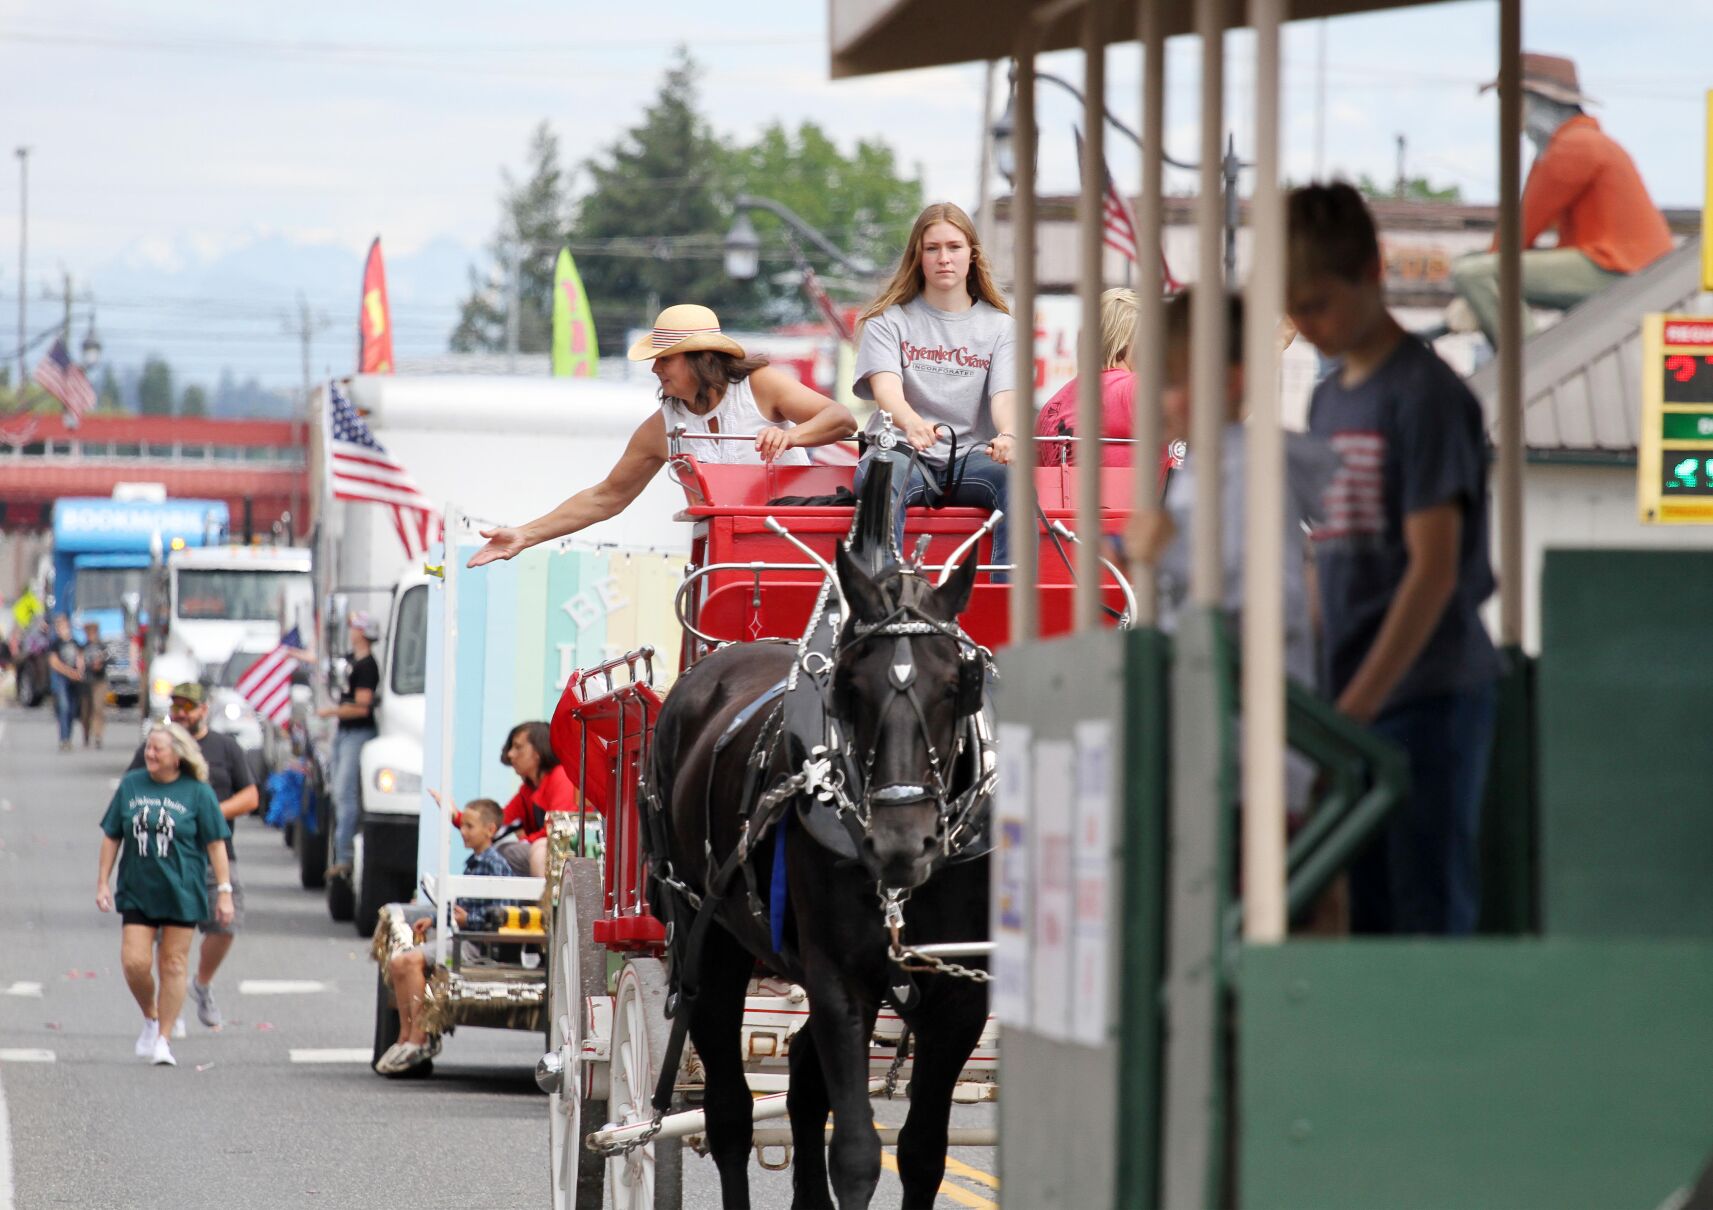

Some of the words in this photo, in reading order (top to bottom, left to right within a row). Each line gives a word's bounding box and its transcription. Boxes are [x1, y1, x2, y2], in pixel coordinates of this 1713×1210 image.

[901, 341, 955, 369] Stremler
[913, 363, 975, 376] INCORPORATED
[560, 576, 633, 632] BE
